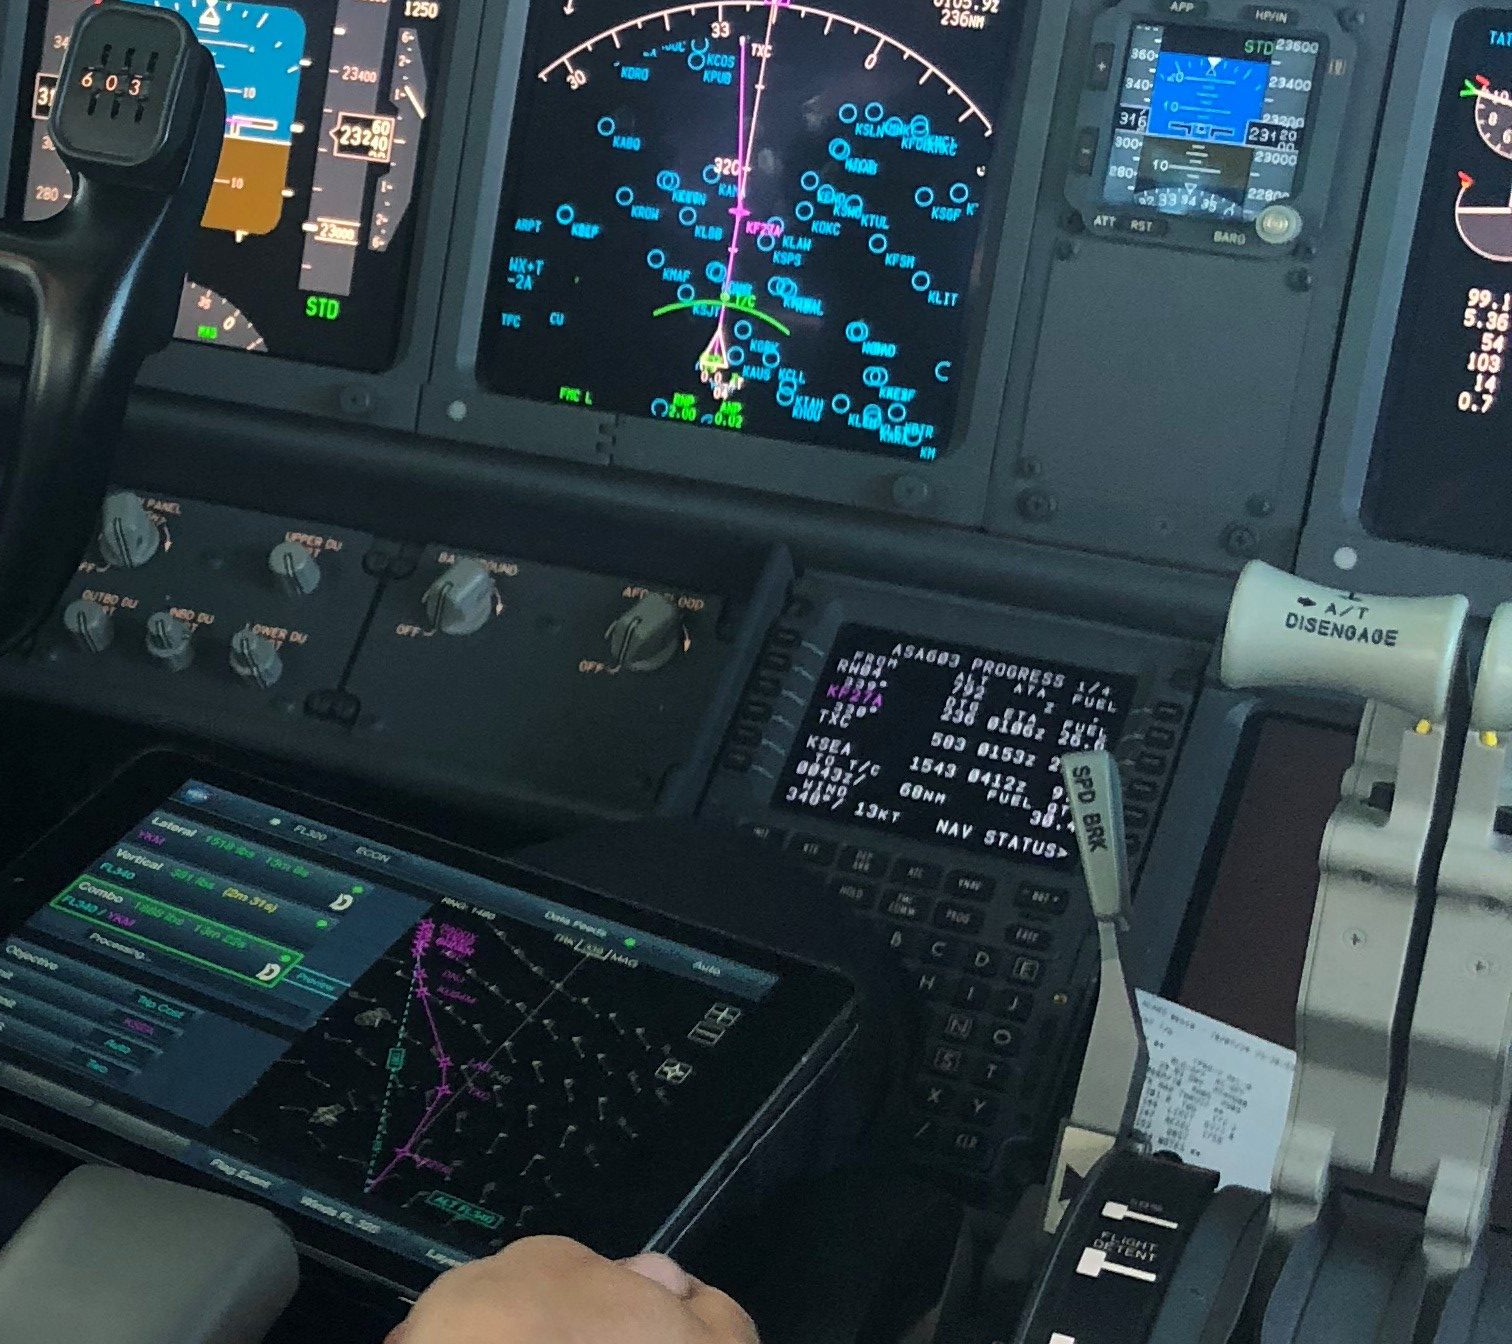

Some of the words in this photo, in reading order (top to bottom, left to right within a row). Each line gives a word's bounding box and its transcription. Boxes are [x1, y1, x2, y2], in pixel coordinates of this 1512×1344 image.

[404, 1, 439, 19] 1250
[1244, 40, 1274, 55] STD
[342, 66, 377, 84] 23400
[306, 297, 340, 320] STD
[1467, 288, 1511, 309] 99.1
[1463, 308, 1510, 331] 5.36
[1466, 351, 1502, 374] 103
[1457, 392, 1494, 415] 0.7
[1324, 602, 1370, 620] A/T
[1285, 612, 1398, 647] DISENGAGE
[971, 657, 1065, 688] PROGRESS
[1077, 681, 1111, 698] 1/4
[1069, 765, 1097, 806] SPD
[1083, 811, 1109, 853] BRK
[936, 819, 973, 840] NAV
[984, 829, 1057, 859] STATUS
[78, 881, 124, 904] Combo
